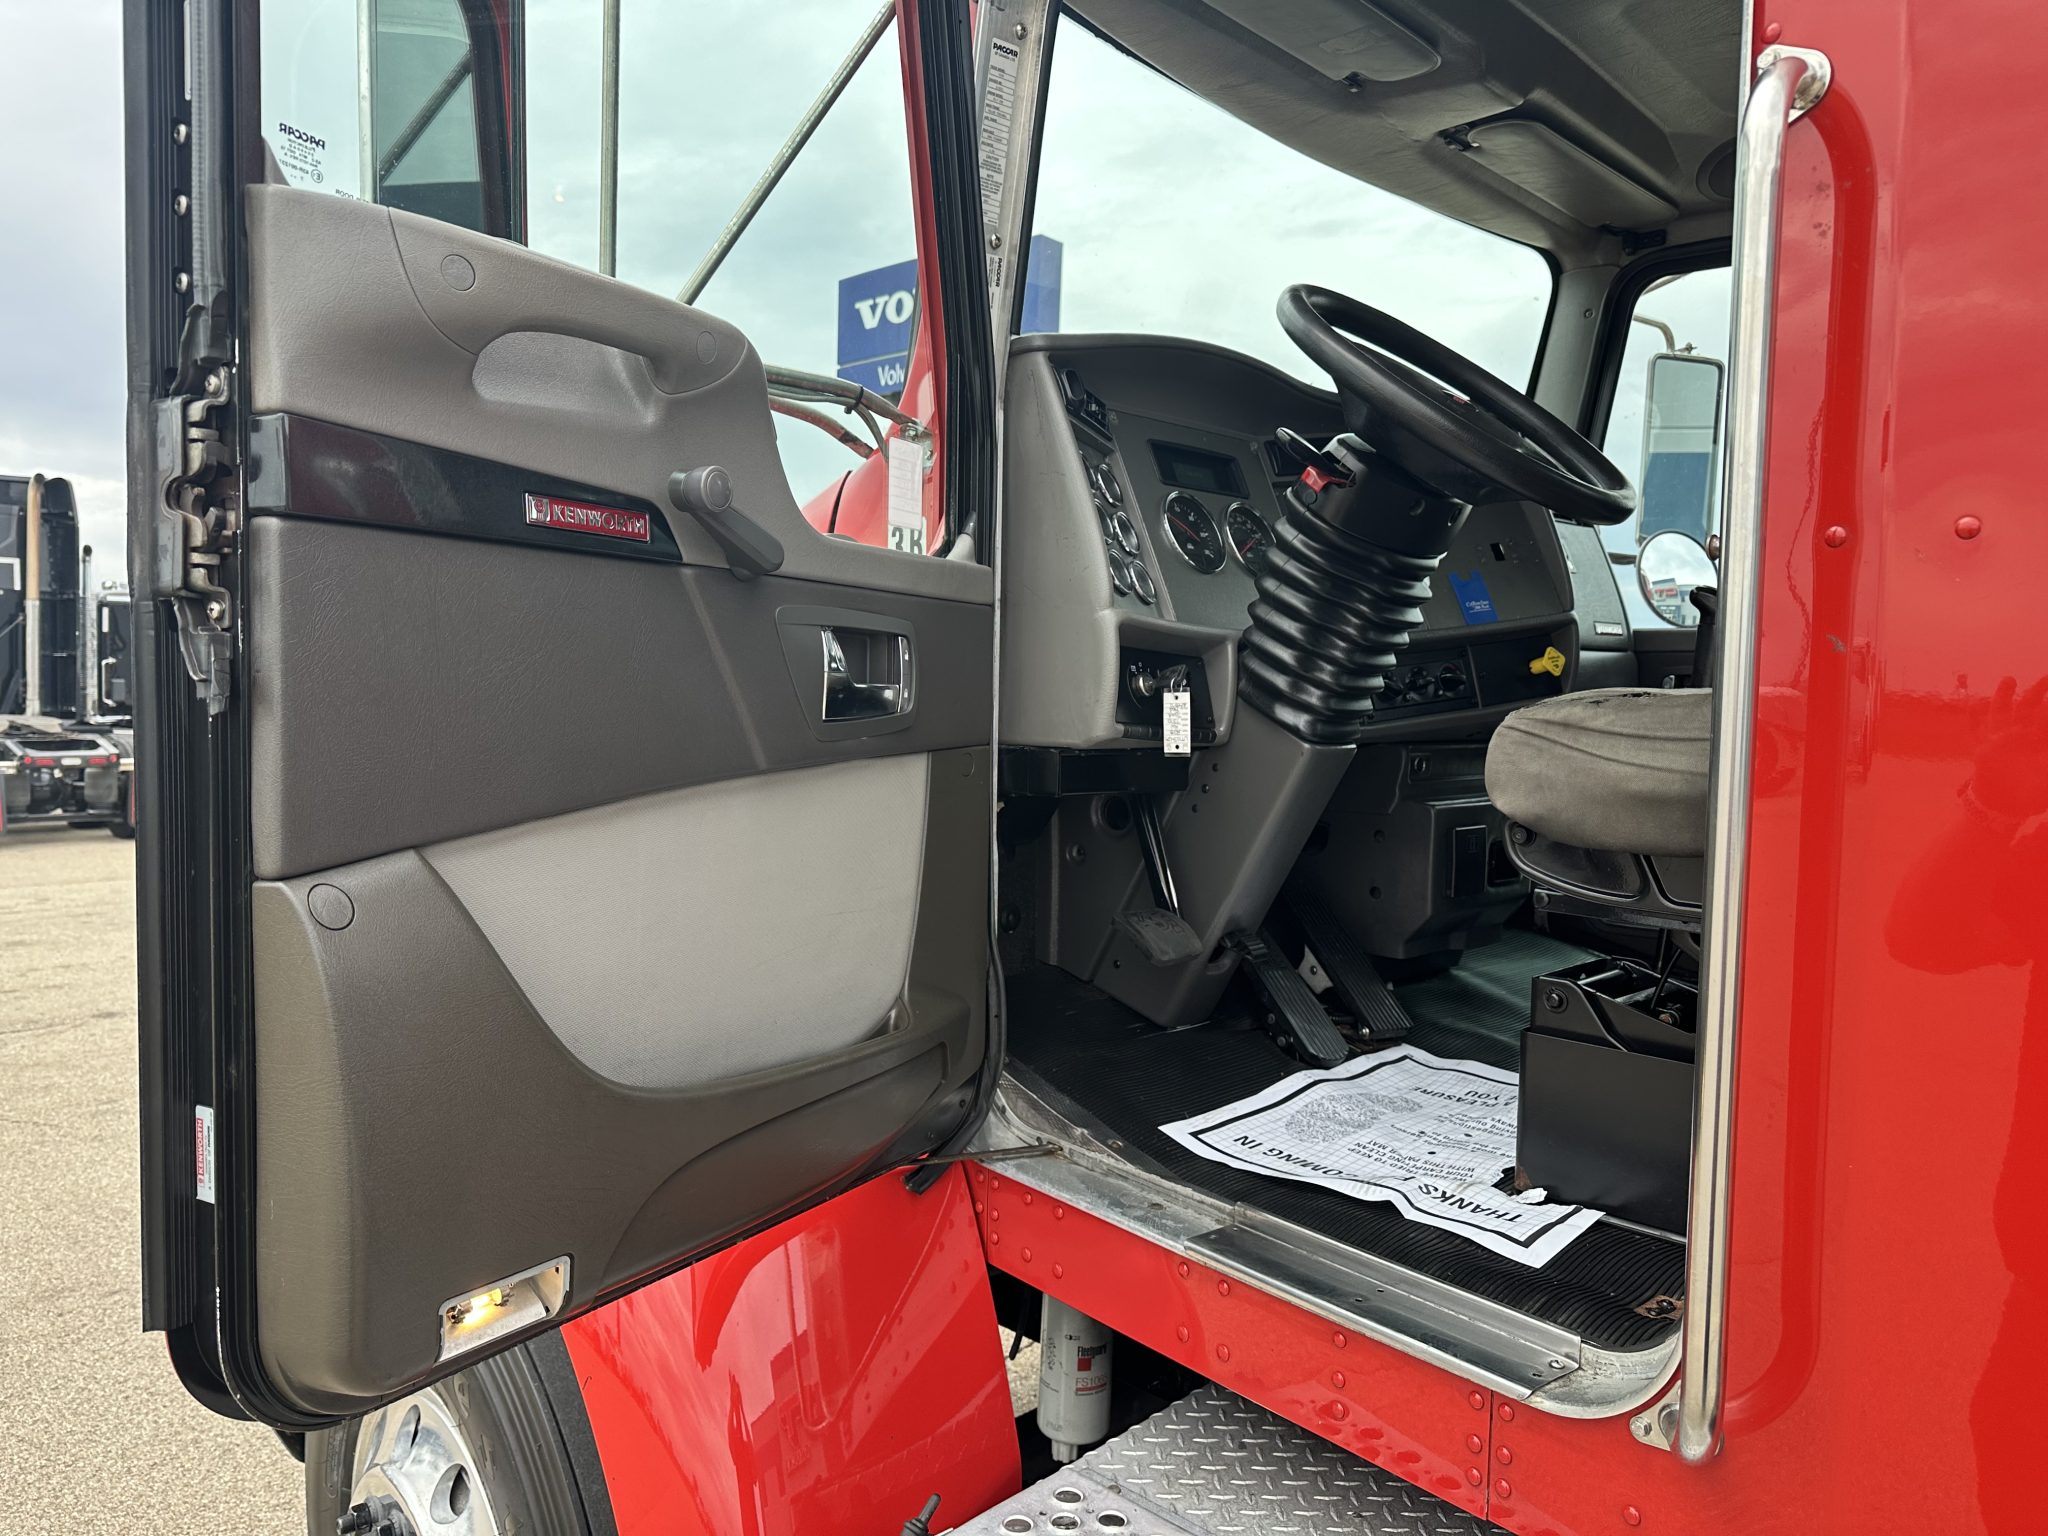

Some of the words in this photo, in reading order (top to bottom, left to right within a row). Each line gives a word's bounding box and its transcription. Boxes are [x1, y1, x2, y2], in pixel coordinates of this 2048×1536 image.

[993, 42, 1018, 58] PACCAR
[854, 288, 916, 330] VO
[552, 503, 645, 534] KENWORTH
[1410, 1087, 1500, 1108] PLEASURE
[1464, 1090, 1501, 1102] YOU
[196, 1118, 204, 1175] KENWORTH
[1233, 1135, 1263, 1151] IN
[1354, 1141, 1387, 1157] CLEAN
[1366, 1140, 1388, 1151] MAT
[1347, 1148, 1373, 1160] KEEP
[1374, 1157, 1388, 1166] TO
[1389, 1149, 1421, 1165] PAPR
[1388, 1154, 1444, 1176] CARPETING
[1389, 1163, 1419, 1176] TRIED
[1422, 1159, 1447, 1171] THIS
[1448, 1163, 1475, 1173] WITH
[1445, 1170, 1475, 1179] YOUR
[1418, 1183, 1522, 1223] THANKS
[1077, 1344, 1107, 1359] Fleetguard
